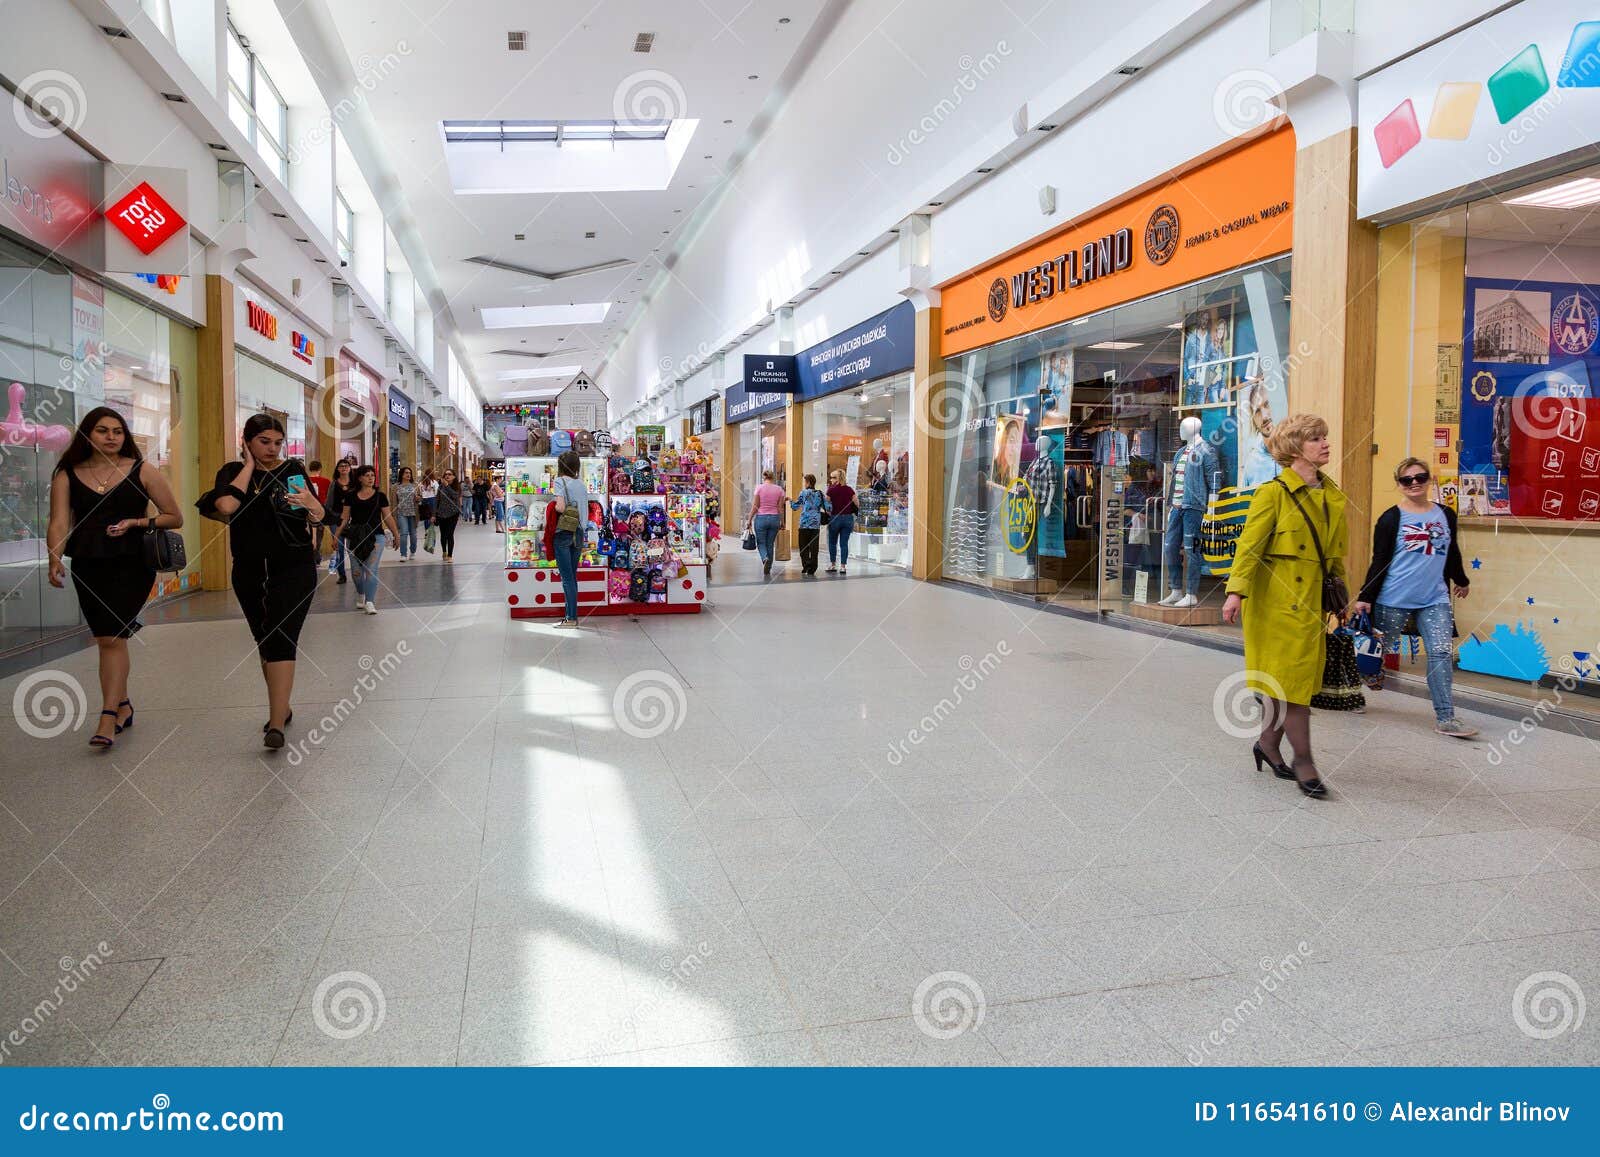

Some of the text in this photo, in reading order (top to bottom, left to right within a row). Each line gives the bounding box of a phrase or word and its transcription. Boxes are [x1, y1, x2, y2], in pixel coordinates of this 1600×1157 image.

[119, 195, 152, 225] TOY
[1221, 214, 1258, 235] CASUAL
[1260, 201, 1290, 220] WEAR
[1011, 228, 1133, 308] WESTLAND
[1193, 537, 1237, 558] РАСПРО
